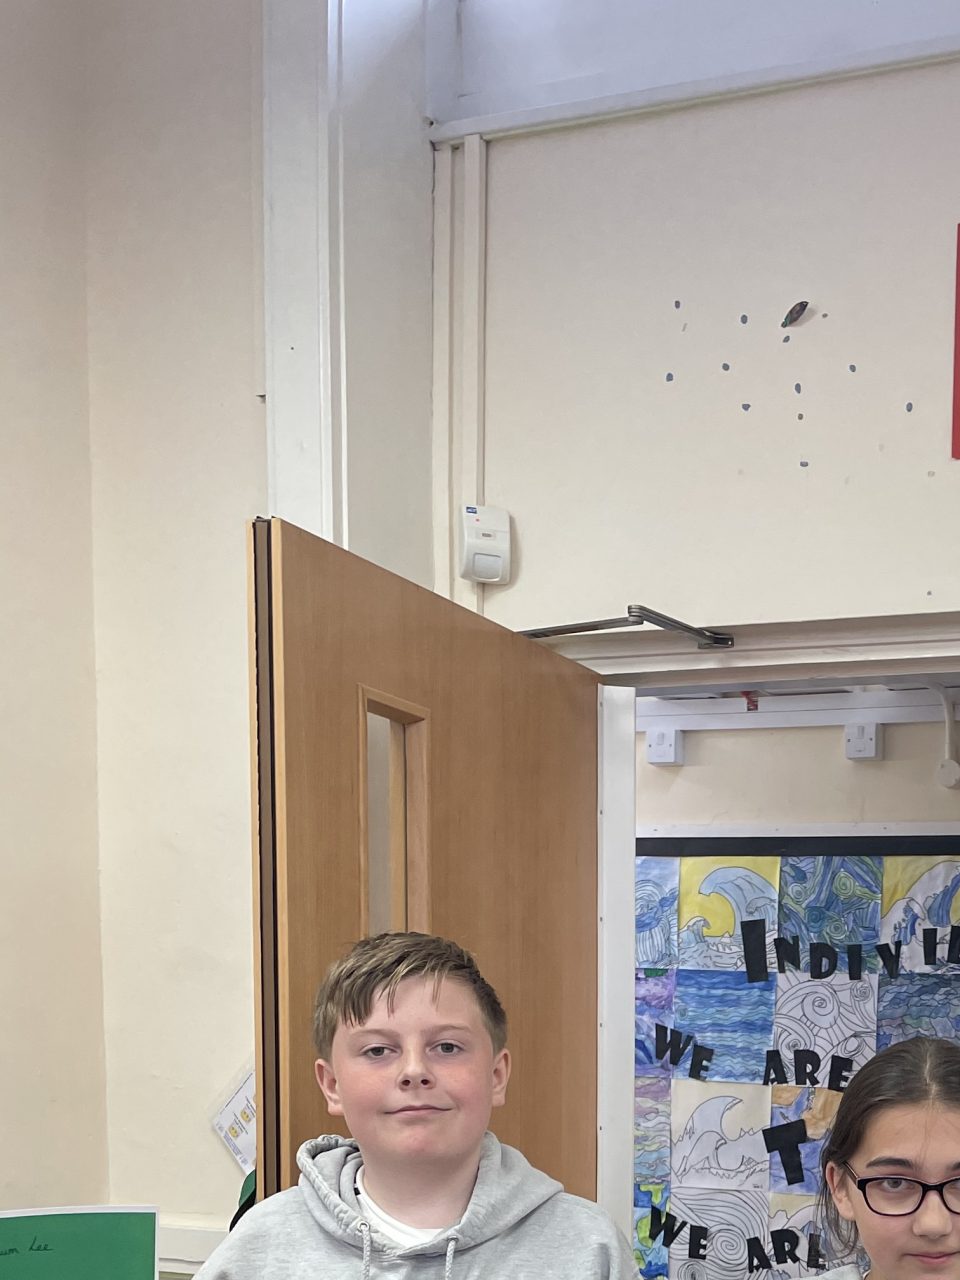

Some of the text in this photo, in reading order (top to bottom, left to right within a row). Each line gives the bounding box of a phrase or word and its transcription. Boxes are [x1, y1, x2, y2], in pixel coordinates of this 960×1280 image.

[655, 1024, 714, 1082] WE
[763, 1048, 853, 1093] ARE
[28, 1234, 55, 1251] Lee
[649, 1205, 707, 1260] WE
